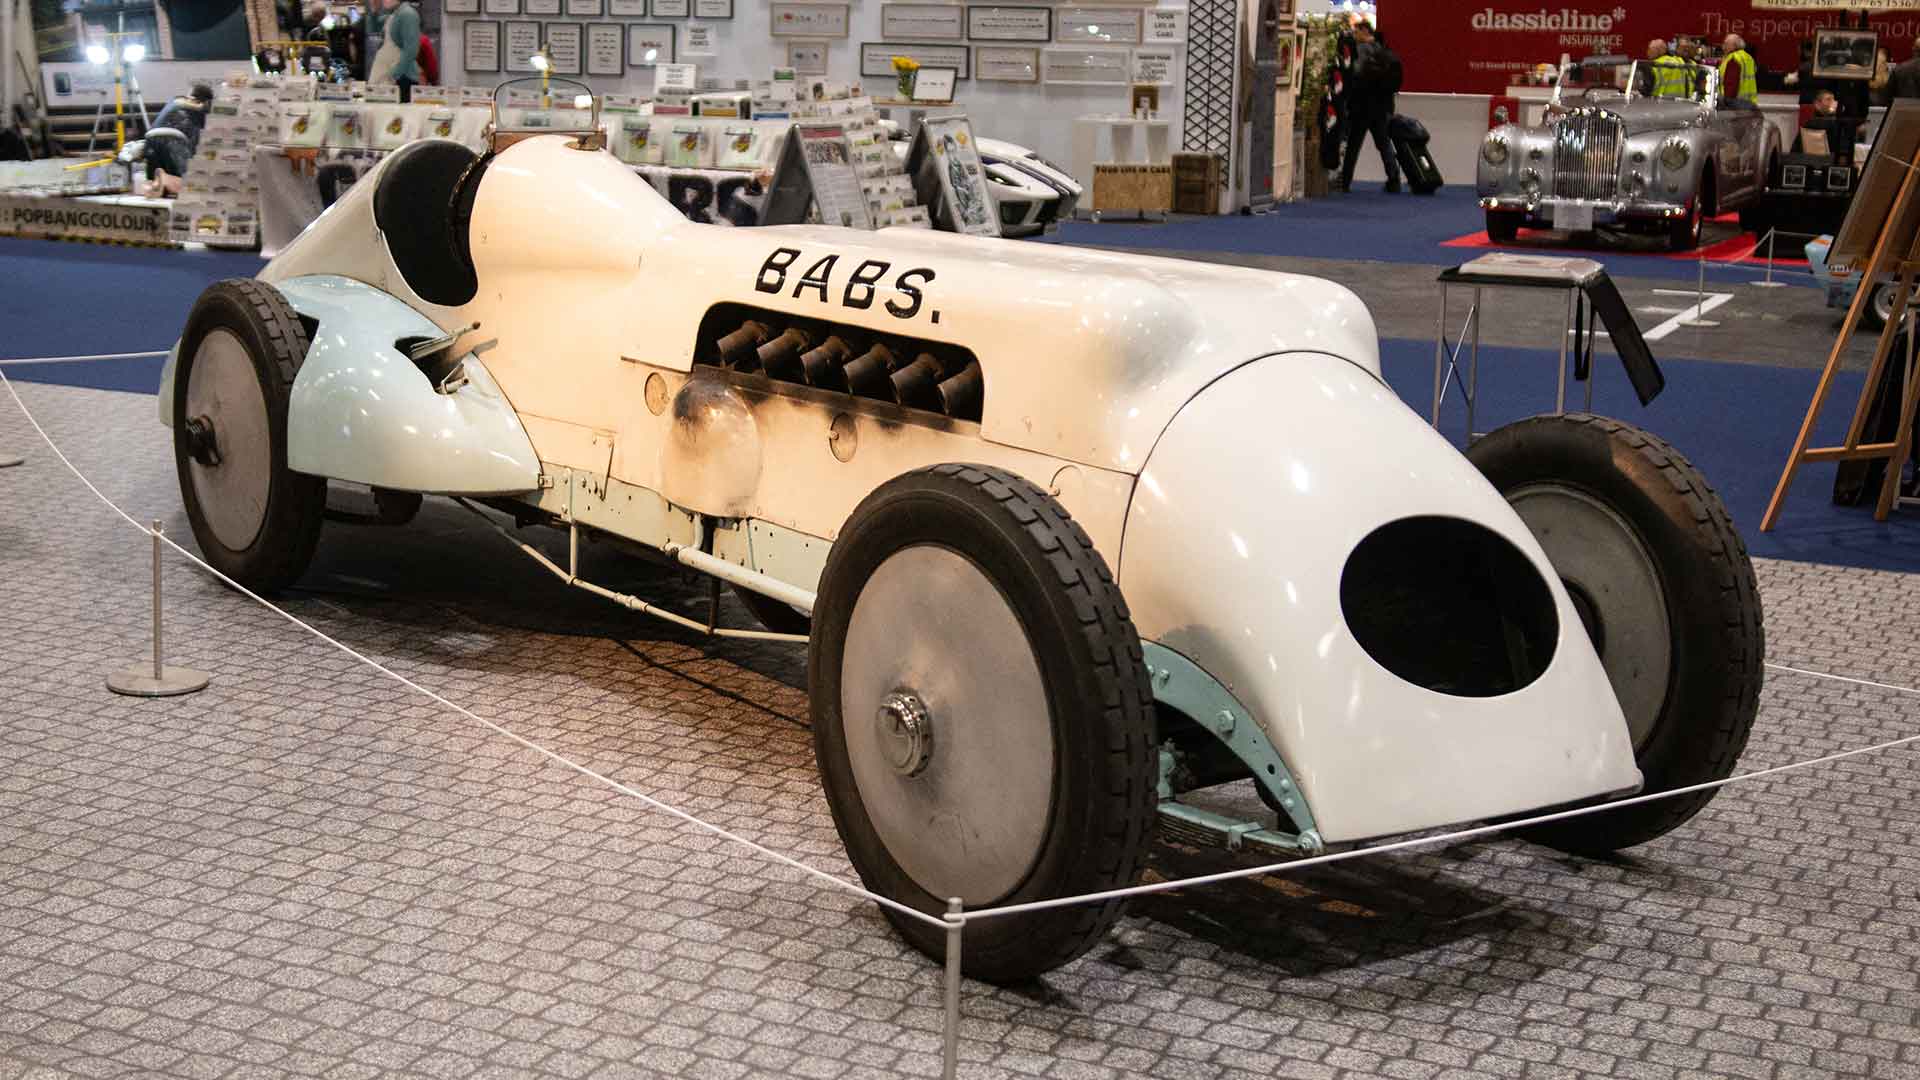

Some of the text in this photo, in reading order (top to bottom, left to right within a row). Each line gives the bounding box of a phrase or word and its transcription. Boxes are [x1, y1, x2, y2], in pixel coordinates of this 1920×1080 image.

[1701, 12, 1744, 34] The
[1559, 34, 1624, 47] INSURANCE
[13, 208, 159, 231] POPBANGCOLOUR
[754, 247, 941, 324] BABS.
